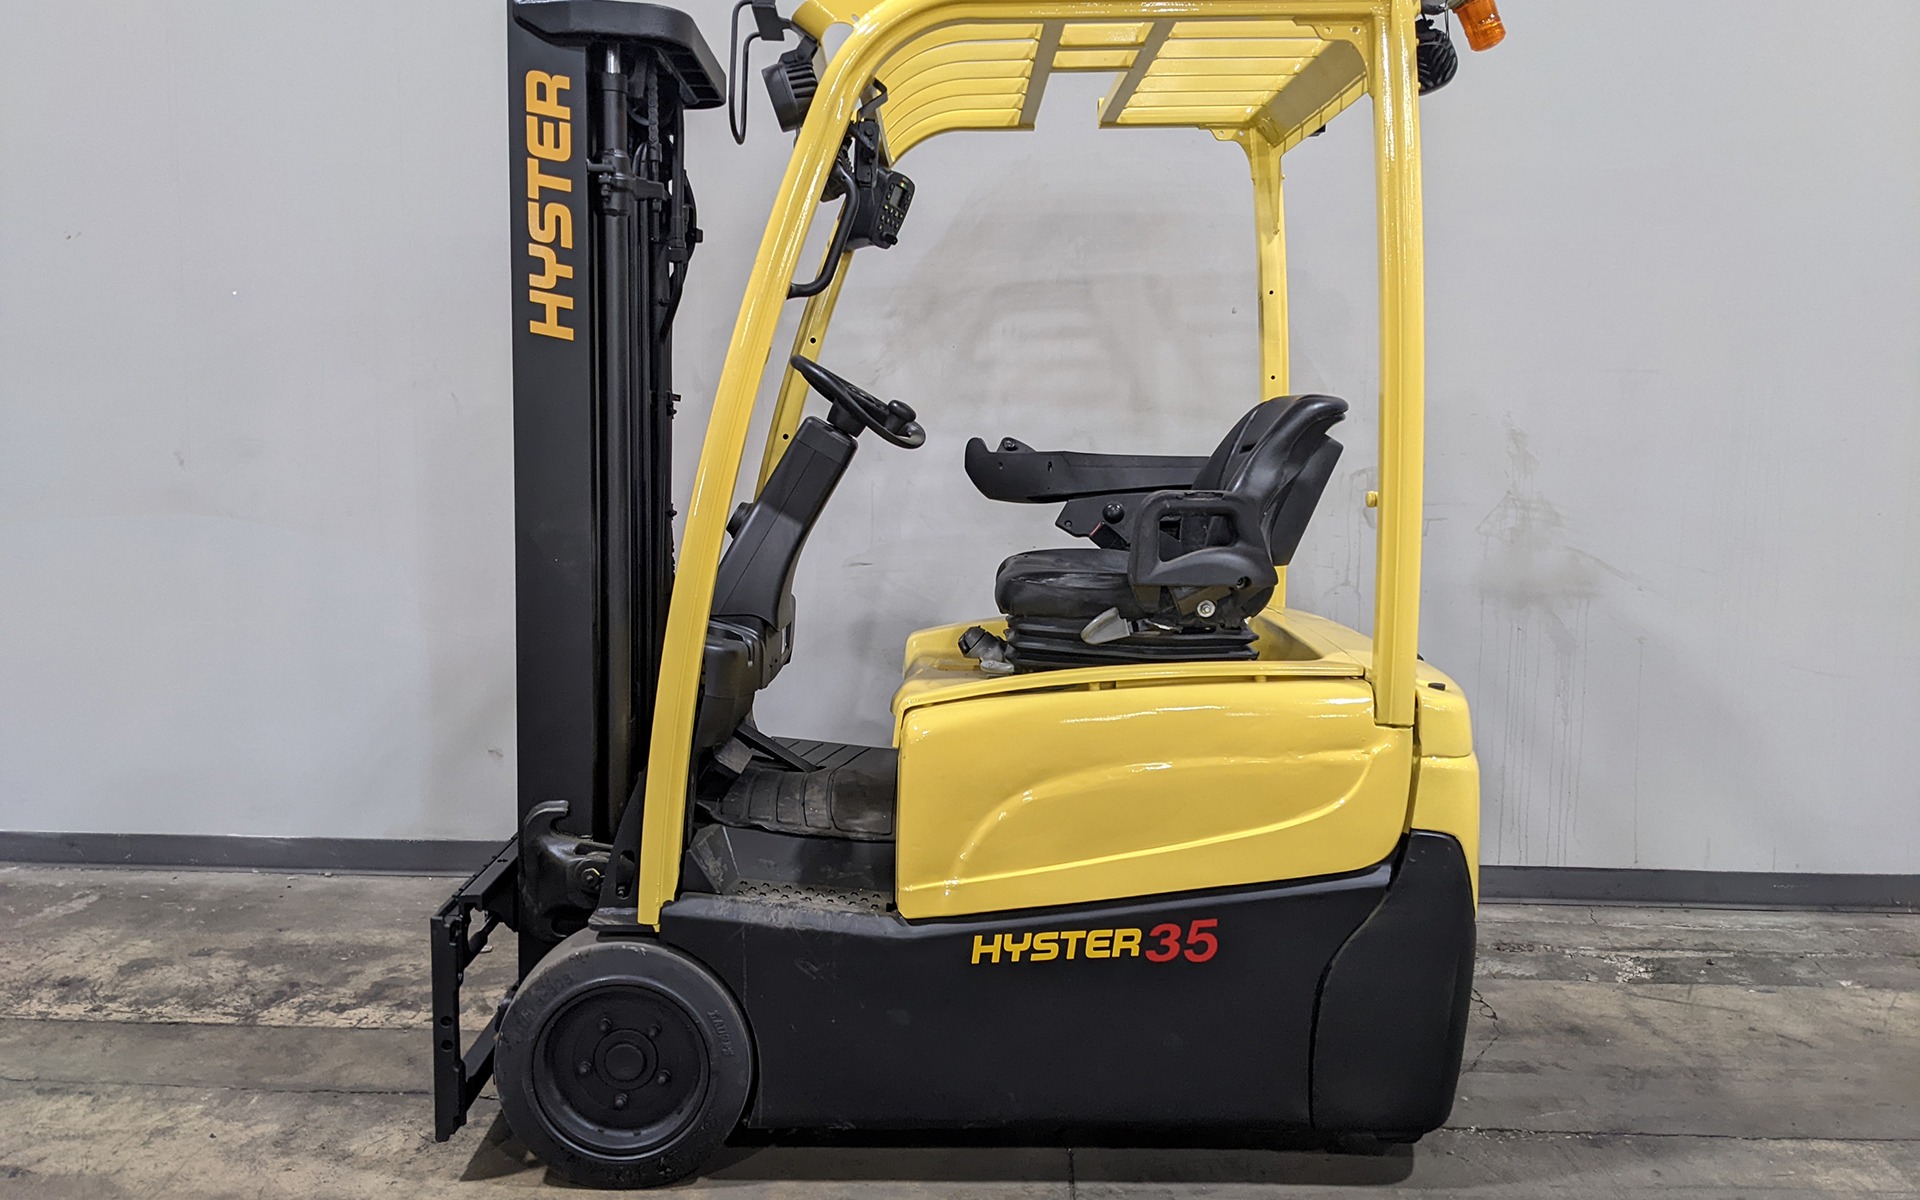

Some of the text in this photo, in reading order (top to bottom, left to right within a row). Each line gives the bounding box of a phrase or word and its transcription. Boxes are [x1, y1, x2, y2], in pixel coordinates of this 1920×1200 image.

[525, 69, 575, 342] HYSTER
[970, 918, 1219, 965] HYSTER 35
